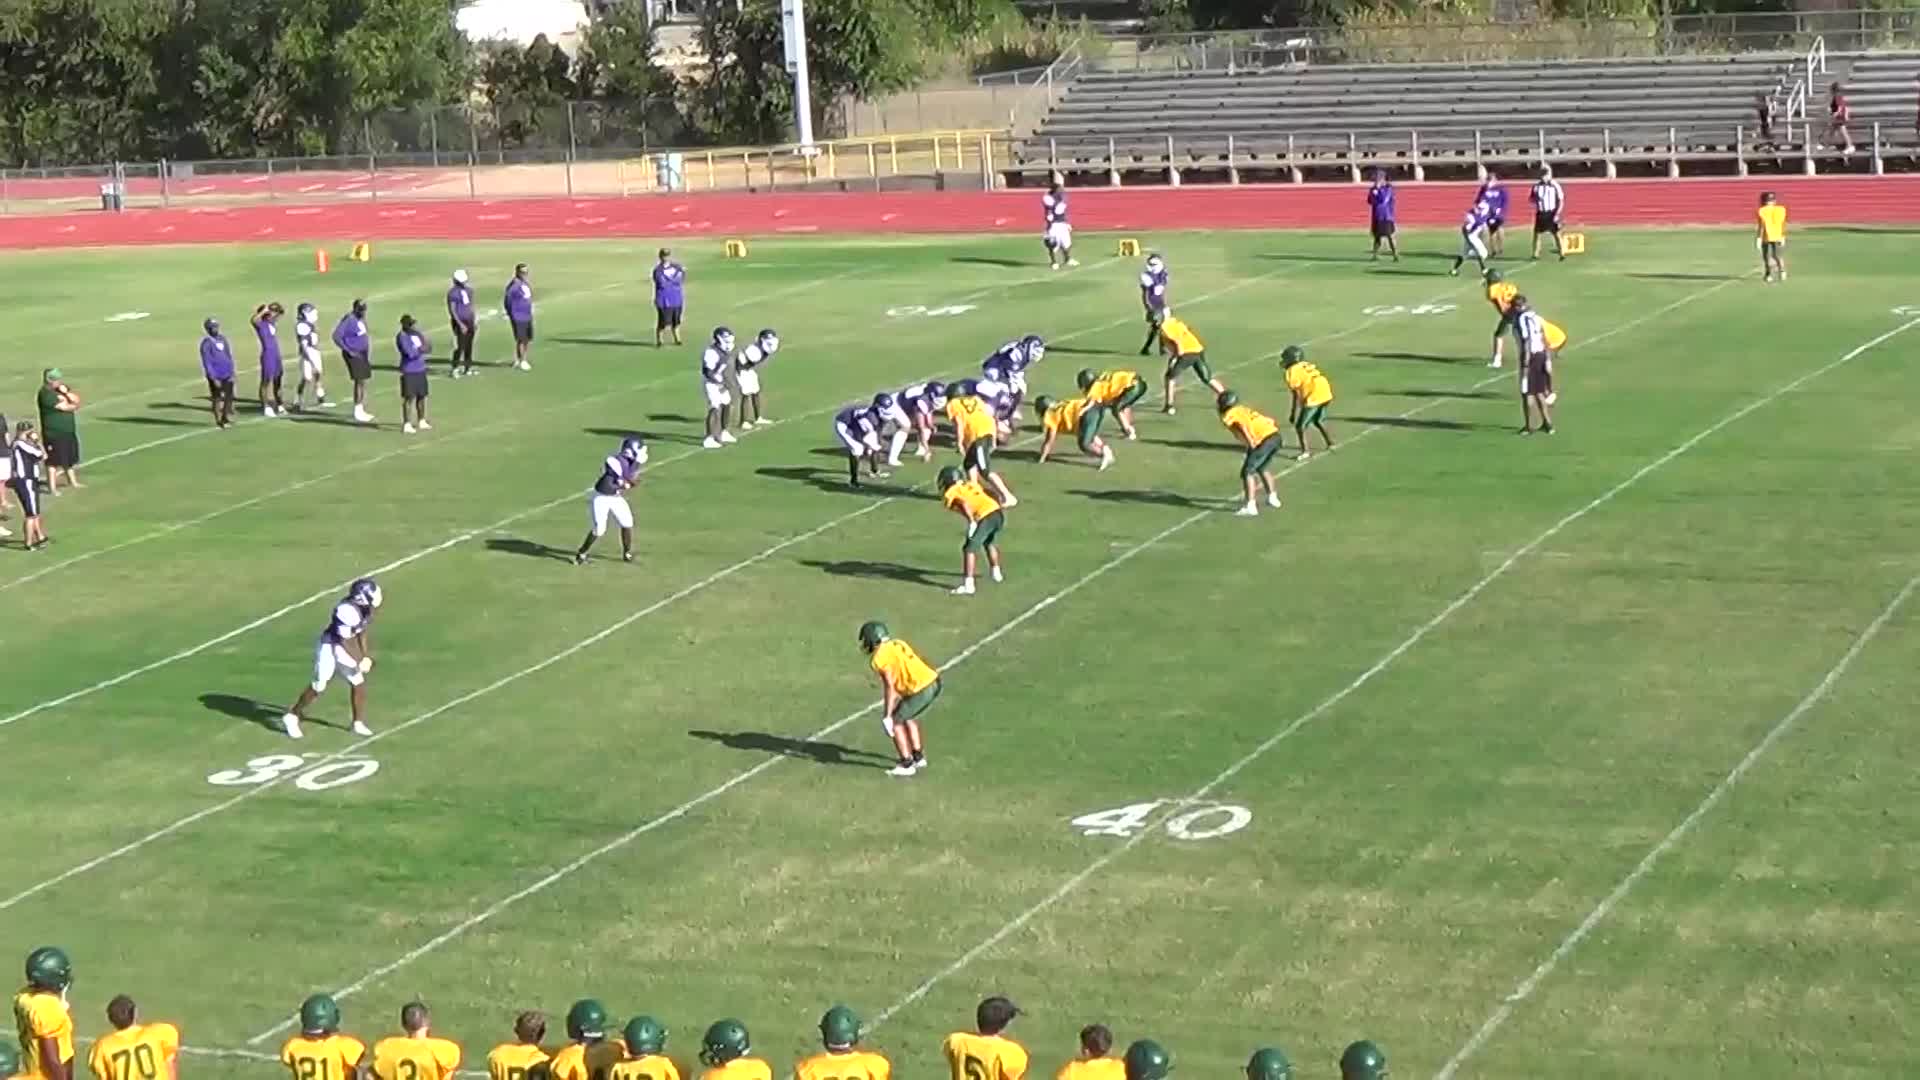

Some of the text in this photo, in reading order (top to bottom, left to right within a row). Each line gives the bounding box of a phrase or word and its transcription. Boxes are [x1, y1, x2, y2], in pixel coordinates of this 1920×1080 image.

[207, 753, 380, 791] 30
[1071, 800, 1253, 840] 40
[111, 1043, 156, 1080] 70
